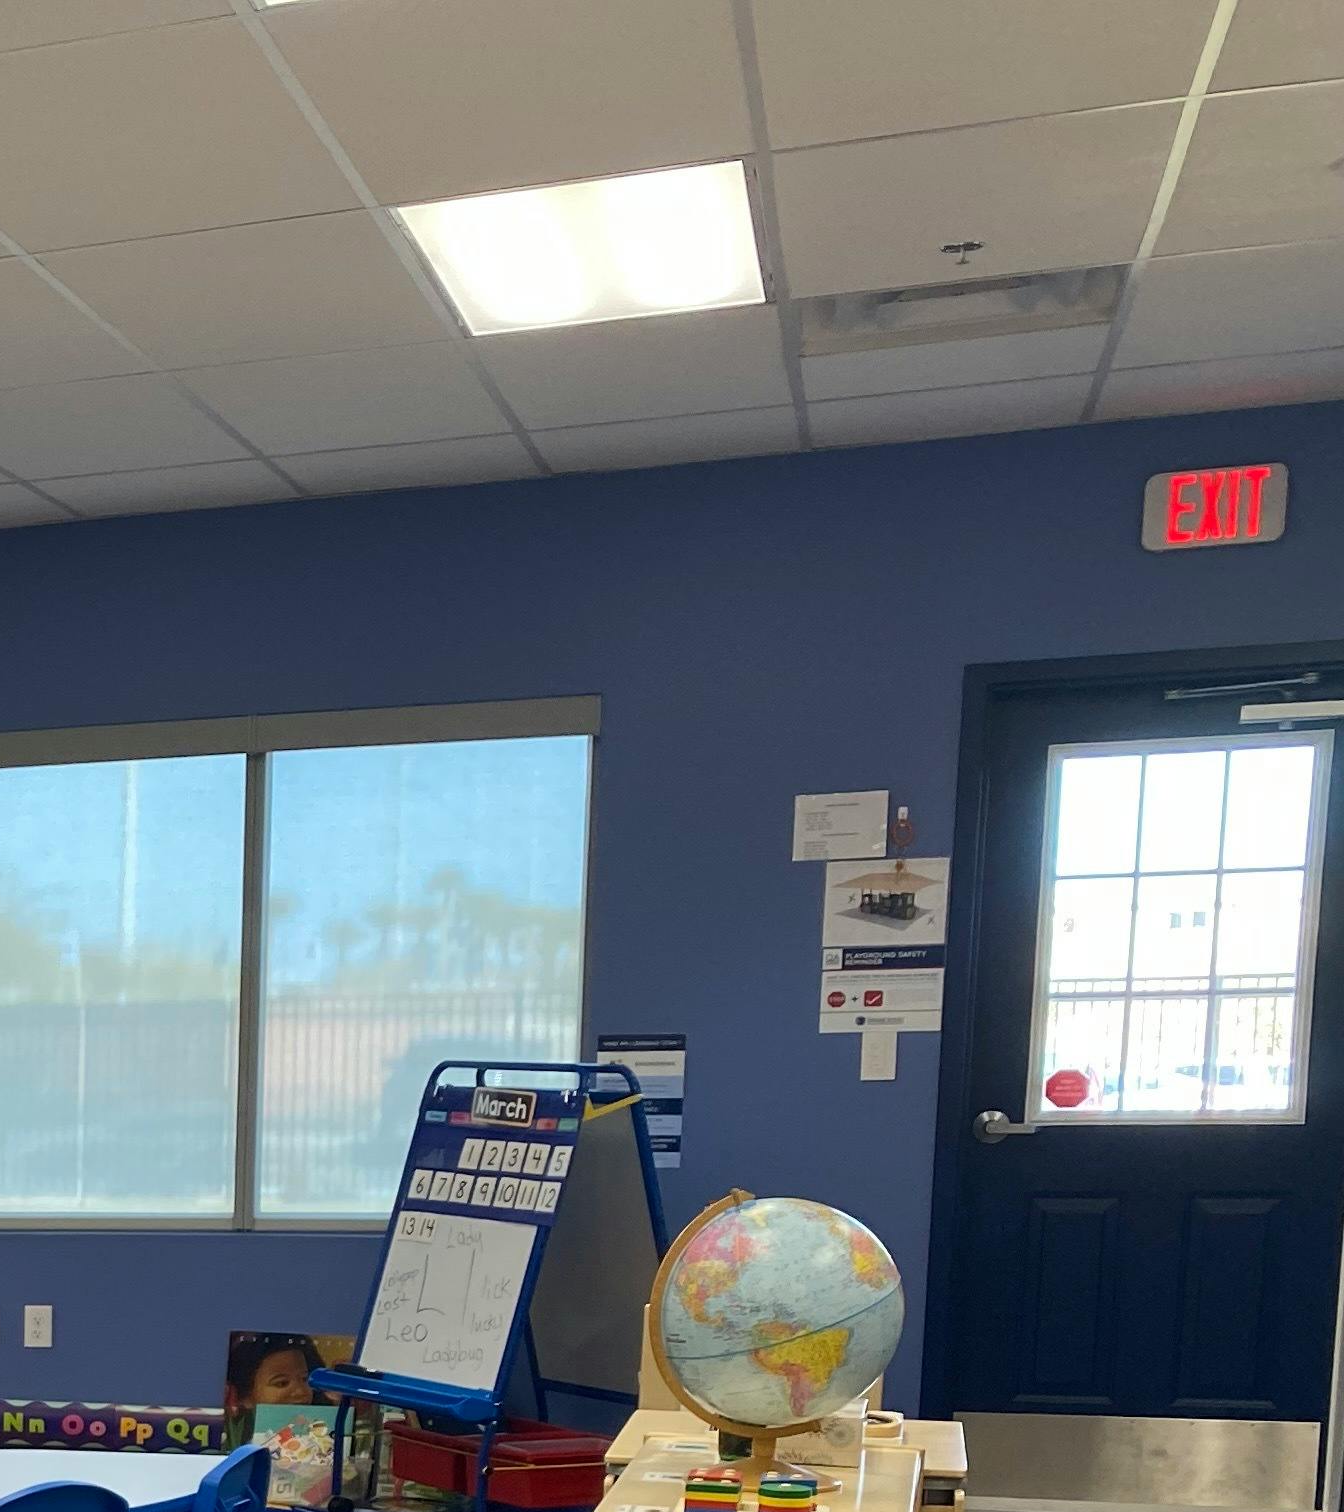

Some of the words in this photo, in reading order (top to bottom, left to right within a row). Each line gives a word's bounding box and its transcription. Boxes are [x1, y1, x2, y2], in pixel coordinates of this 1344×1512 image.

[1166, 466, 1272, 545] EXIT
[475, 1092, 527, 1120] March
[467, 1145, 475, 1163] 1
[487, 1146, 498, 1166] 2
[508, 1148, 518, 1167] 3
[533, 1149, 542, 1170] 4
[554, 1151, 566, 1171] 5
[416, 1176, 425, 1193] 6
[437, 1177, 447, 1196] 7
[455, 1180, 467, 1199] 8
[480, 1182, 489, 1201] 9
[499, 1182, 514, 1203] 10
[520, 1184, 535, 1206] 11
[539, 1186, 556, 1208] 12
[401, 1216, 415, 1235] 13
[419, 1217, 436, 1238] 14
[385, 1318, 429, 1343] Leo
[422, 1338, 484, 1370] Ladybug
[2, 1411, 46, 1433] Nn
[62, 1414, 107, 1437] Oo
[119, 1416, 154, 1445] Pp
[166, 1418, 210, 1446] Qq
